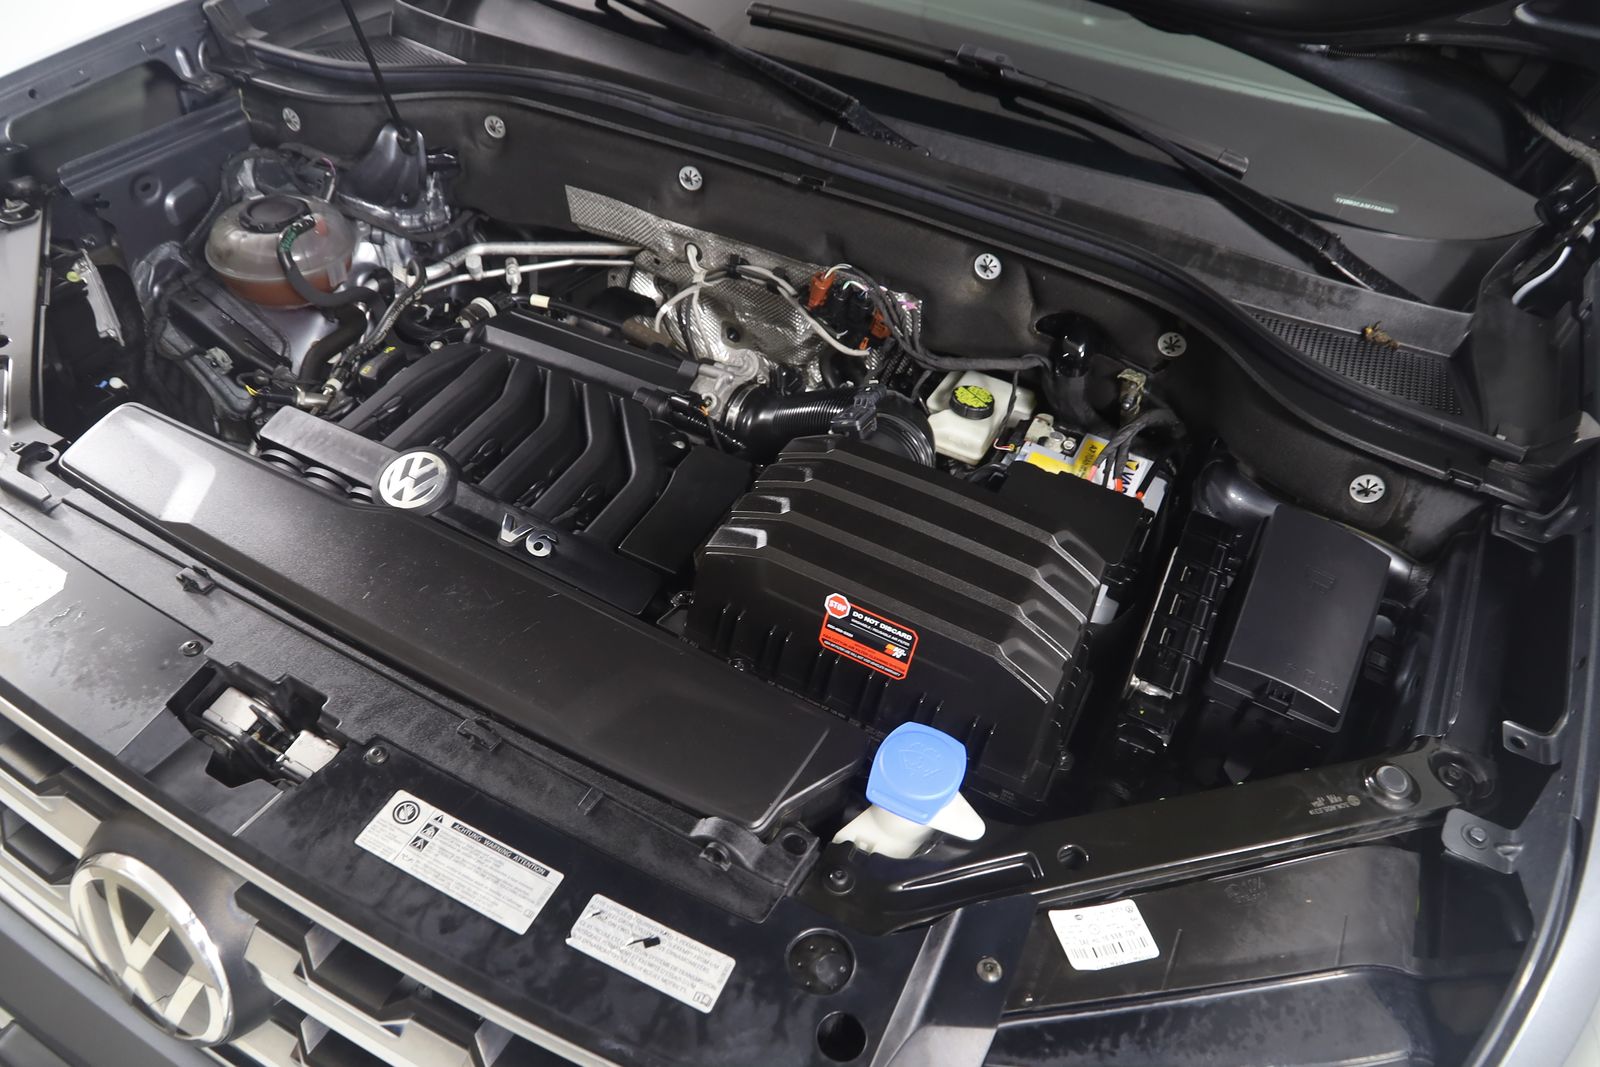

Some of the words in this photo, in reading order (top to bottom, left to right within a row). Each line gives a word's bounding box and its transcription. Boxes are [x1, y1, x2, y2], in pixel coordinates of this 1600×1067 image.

[500, 512, 557, 557] V6
[829, 600, 847, 611] STOP
[852, 611, 864, 620] DO
[864, 616, 880, 626] NOT
[880, 623, 912, 640] DISCARD
[454, 824, 482, 842] ACHTUNG
[483, 839, 512, 858] WARNING
[513, 855, 546, 875] ATTENTION
